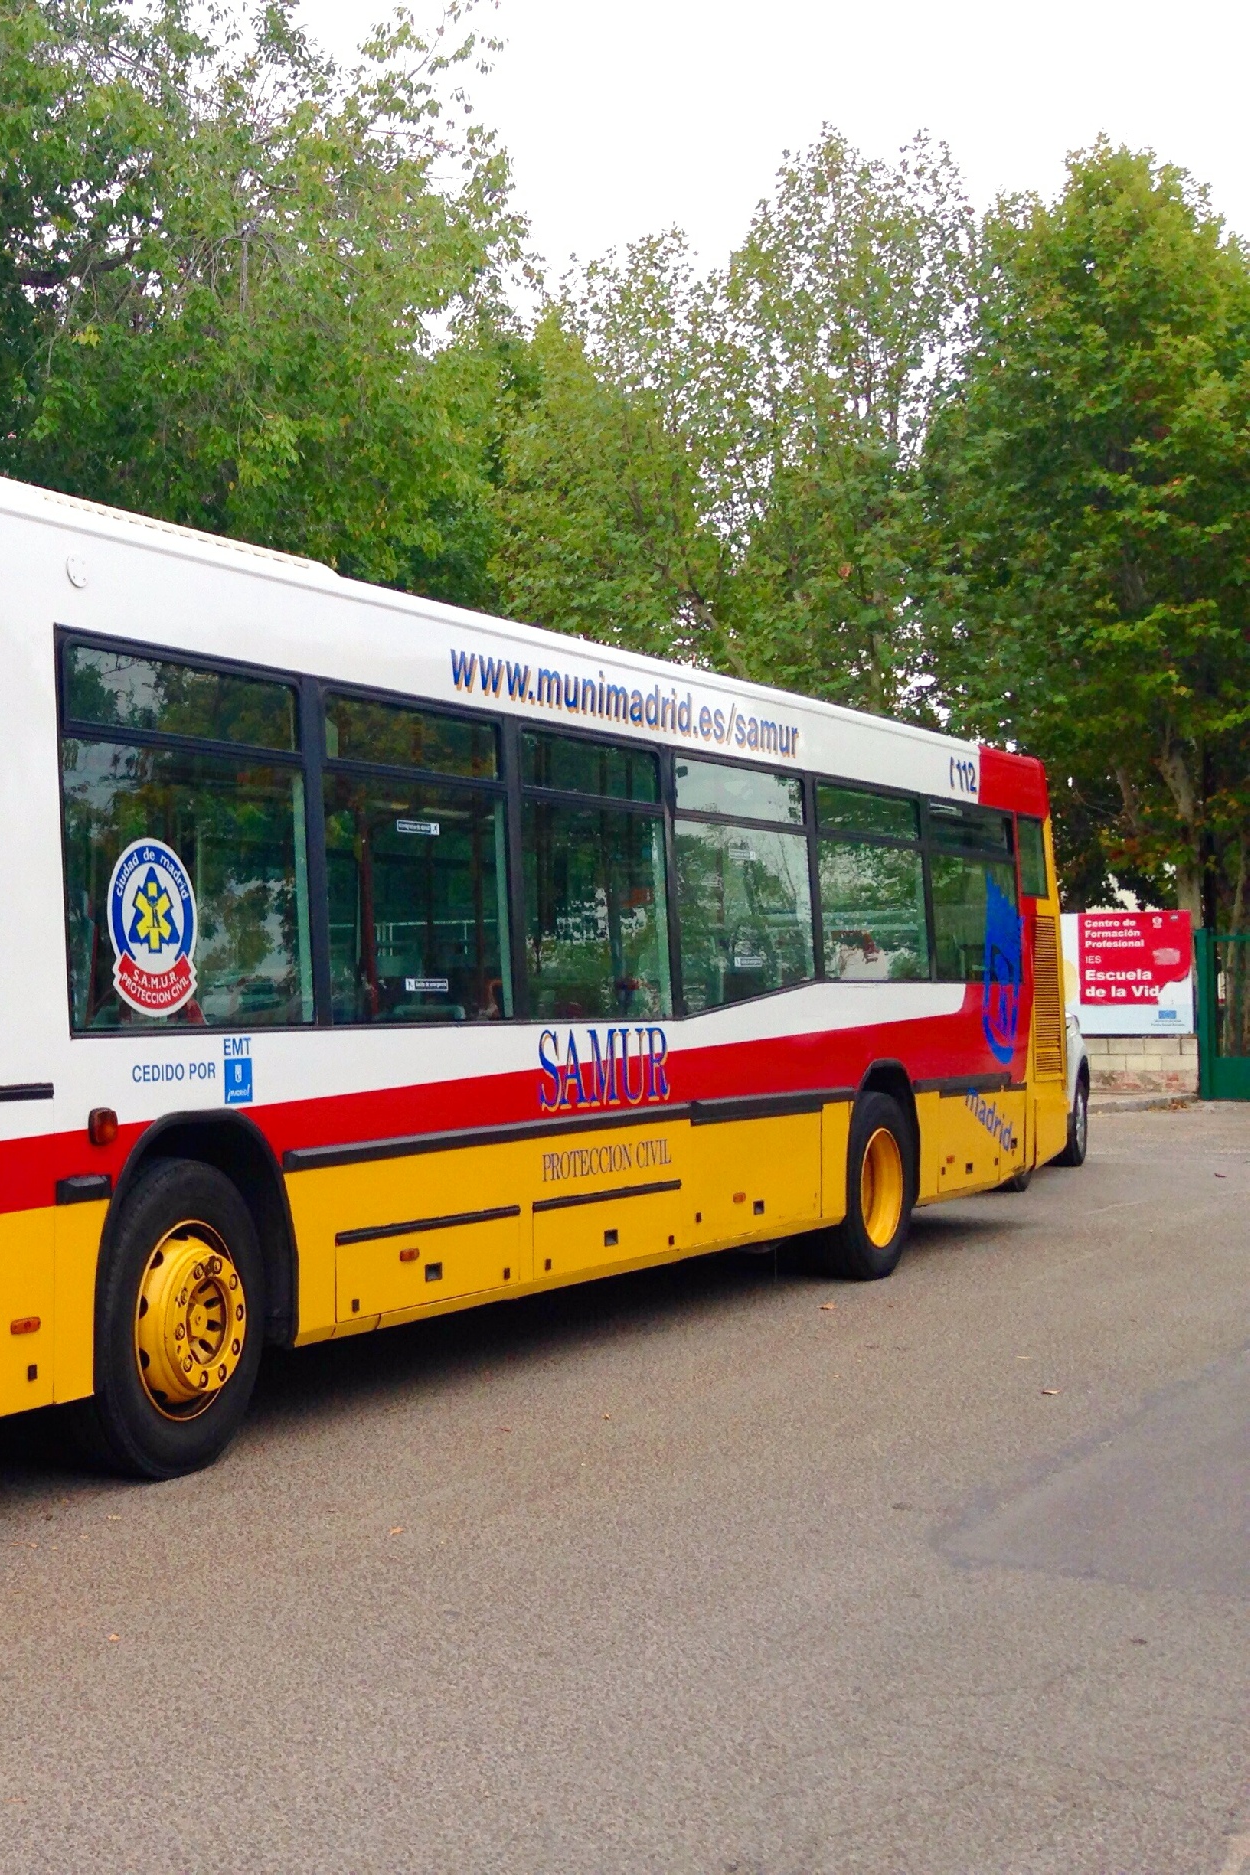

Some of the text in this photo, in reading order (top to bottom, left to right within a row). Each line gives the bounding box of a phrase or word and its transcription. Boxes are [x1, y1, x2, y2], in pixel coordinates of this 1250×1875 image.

[450, 649, 800, 759] www.munimadrid.es/samur
[956, 760, 978, 795] 112
[116, 847, 189, 899] ciudad de madrid
[1084, 918, 1136, 928] Centro de
[1084, 928, 1141, 938] Formación
[1084, 939, 1145, 948] Profesional
[1085, 955, 1102, 964] IES
[1085, 968, 1152, 981] Escuela
[121, 972, 190, 1004] PROTECCION CIVIL
[1085, 985, 1161, 997] de la Vid
[223, 1037, 251, 1056] EMT
[132, 1061, 216, 1083] CEDIDO POR
[538, 1026, 671, 1112] SAMUR
[965, 1087, 1014, 1152] madrid
[542, 1138, 671, 1182] PROTECCION CIVIL
